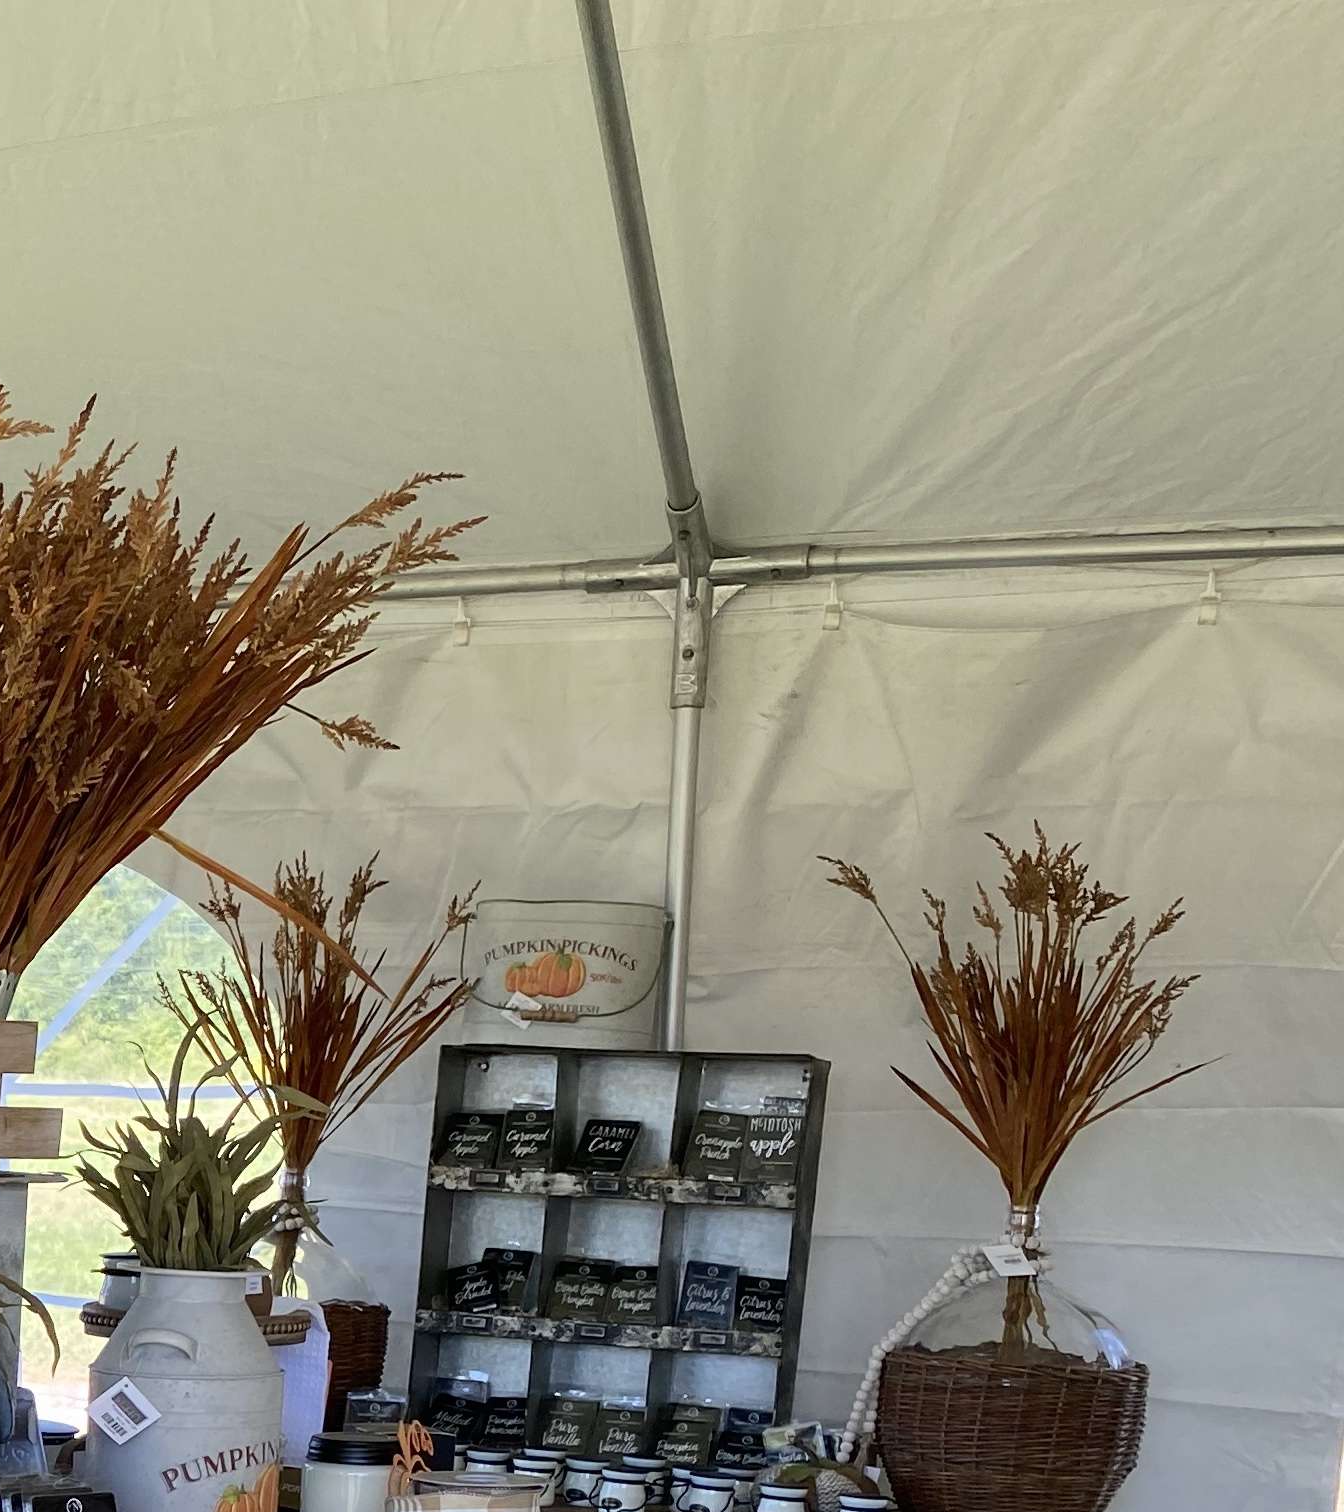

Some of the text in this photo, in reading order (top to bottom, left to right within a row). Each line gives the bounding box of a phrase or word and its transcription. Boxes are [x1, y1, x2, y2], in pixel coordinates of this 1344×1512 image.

[483, 938, 640, 973] PUMPKIN PICKINGS
[448, 1130, 493, 1143] Caramel
[505, 1128, 551, 1143] Caramel
[587, 1137, 623, 1153] Corn
[750, 1130, 796, 1158] apple
[686, 1283, 718, 1301] Citrus
[684, 1297, 726, 1316] Lavender
[740, 1296, 772, 1310] Citrus
[739, 1307, 781, 1323] Lavender
[551, 1418, 580, 1434] Pure
[606, 1427, 636, 1441] Pure
[542, 1432, 582, 1446] Vanilla
[598, 1439, 639, 1454] Vanilla
